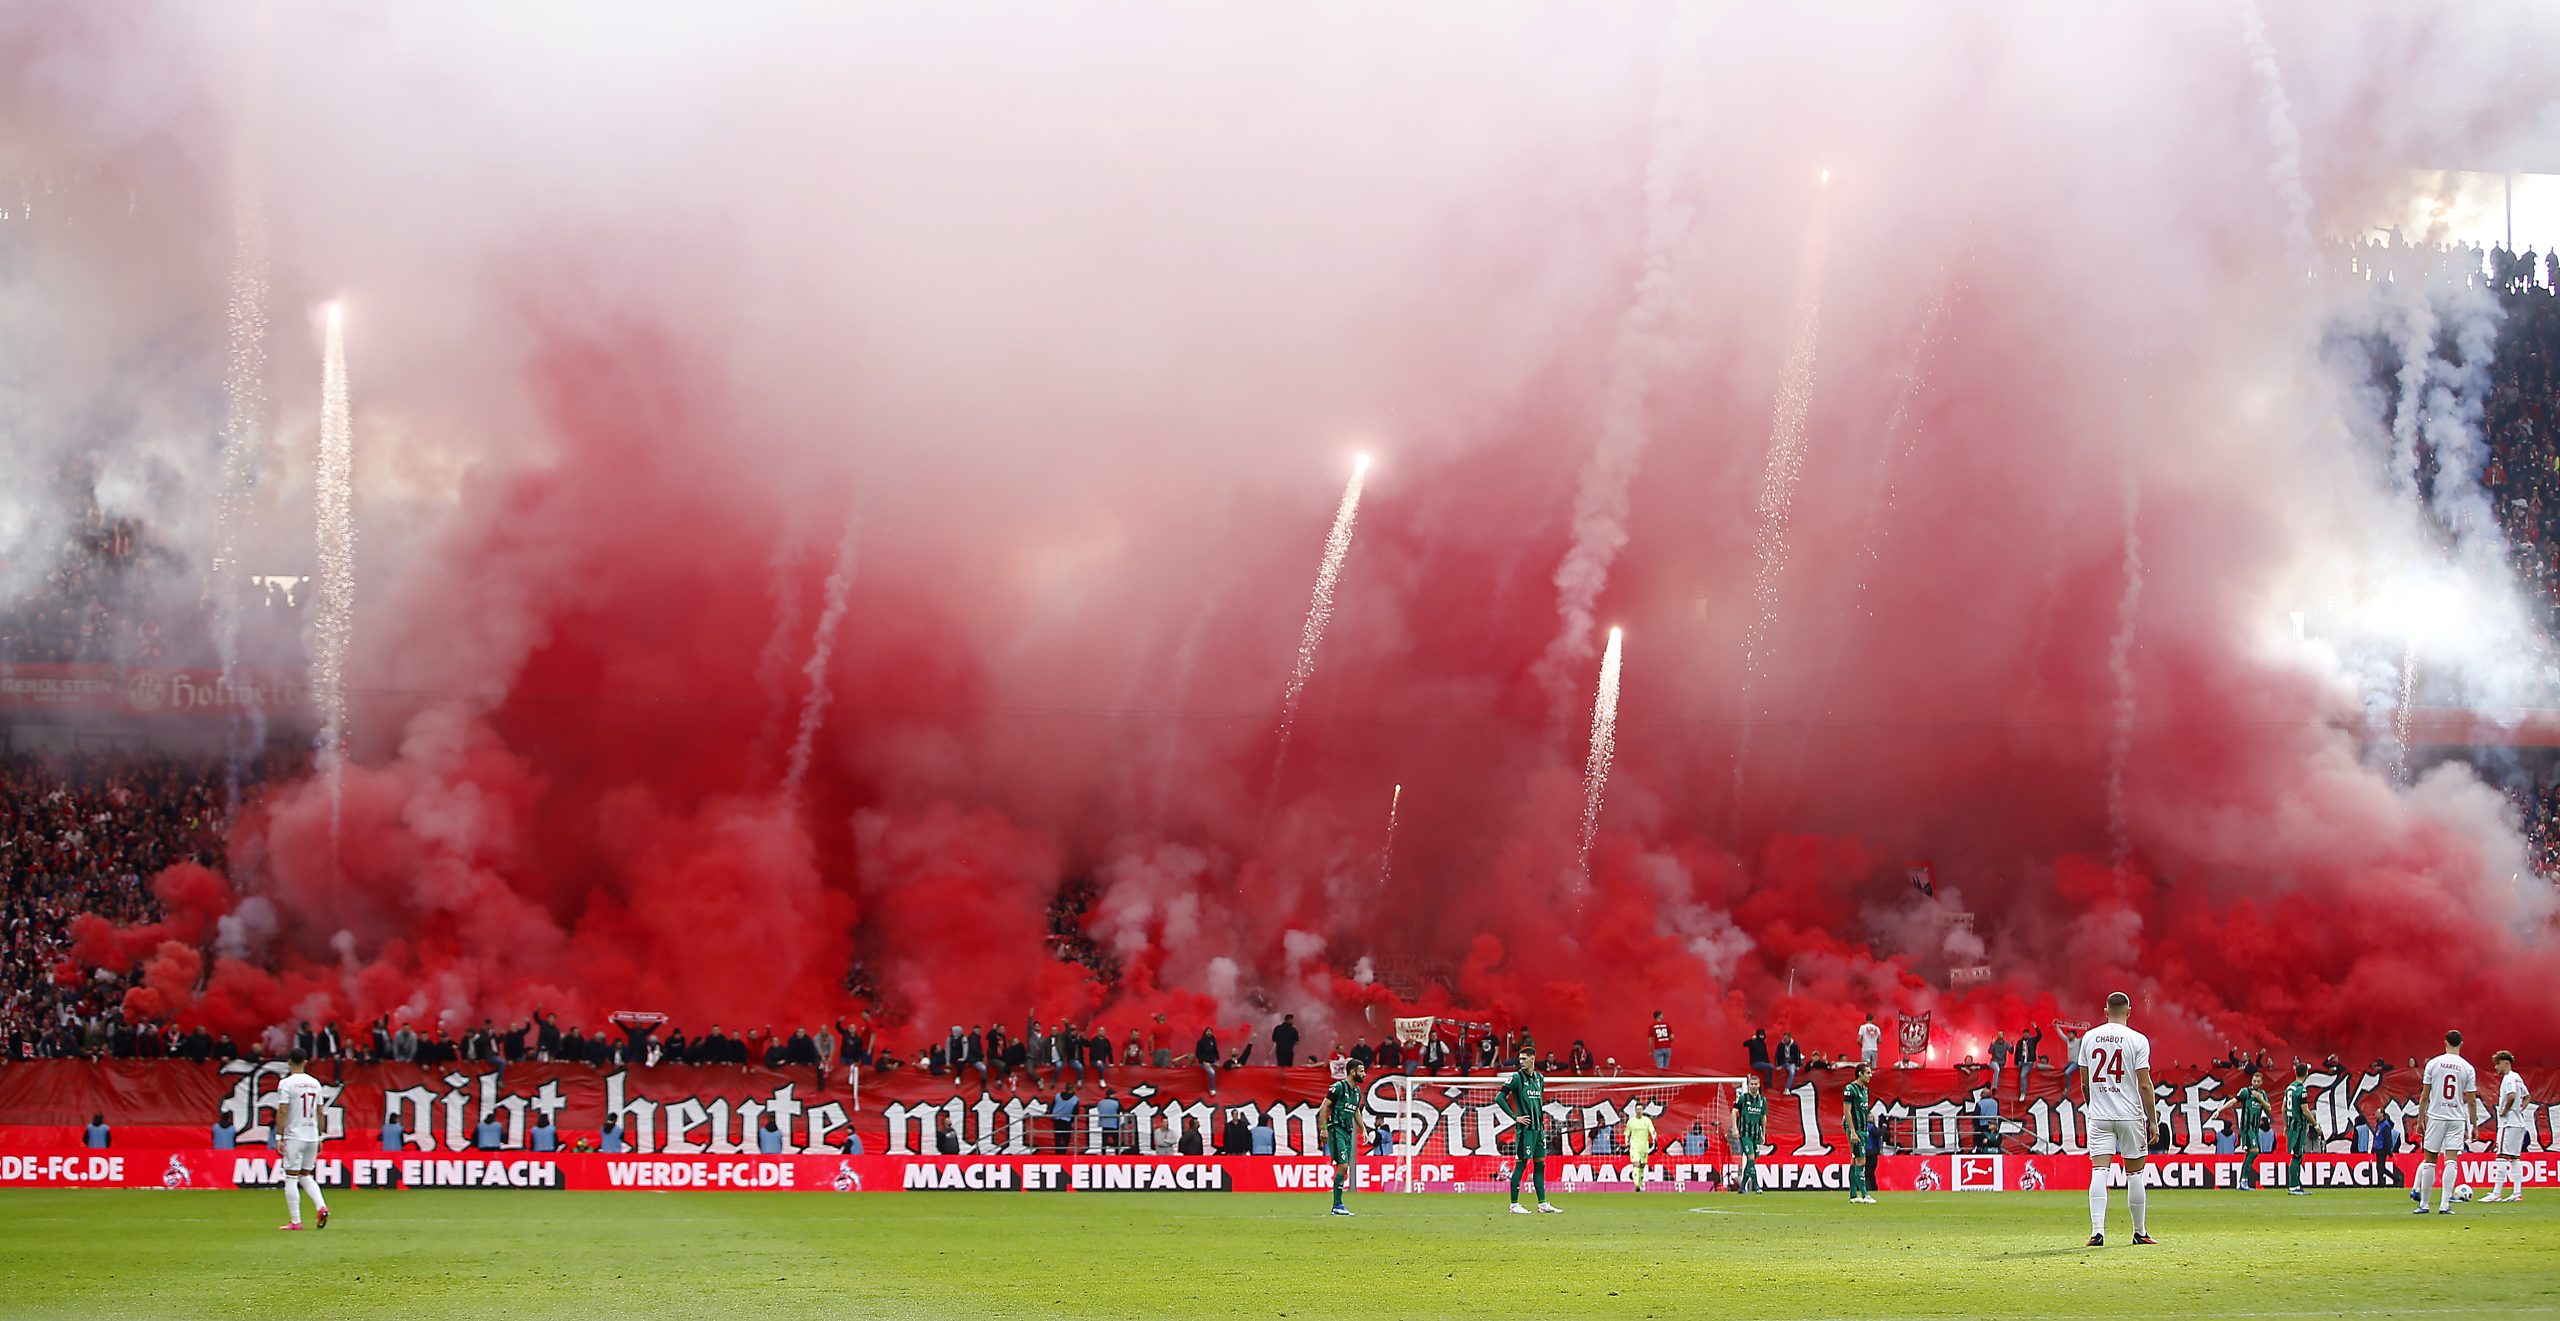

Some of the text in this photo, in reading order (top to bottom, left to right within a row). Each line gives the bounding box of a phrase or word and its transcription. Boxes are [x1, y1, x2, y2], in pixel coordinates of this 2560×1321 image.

[2096, 1036, 2124, 1044] CHABOT
[2092, 1048, 2125, 1083] 24
[2441, 1063, 2461, 1071] MARTEL
[2443, 1074, 2456, 1100] 6
[300, 1093, 317, 1118] 17
[605, 1070, 849, 1154] heute
[884, 1092, 1050, 1155] nur
[2287, 1090, 2293, 1110] 8
[0, 1156, 124, 1181] DE-FC.DE
[232, 1158, 556, 1187] MAH ET EINFACH
[607, 1162, 794, 1187] WERDE-FC.DE
[903, 1163, 1222, 1190] MACH ET EINFACH
[1676, 1164, 1712, 1183] ET
[2461, 1161, 2560, 1183] WERDE-
